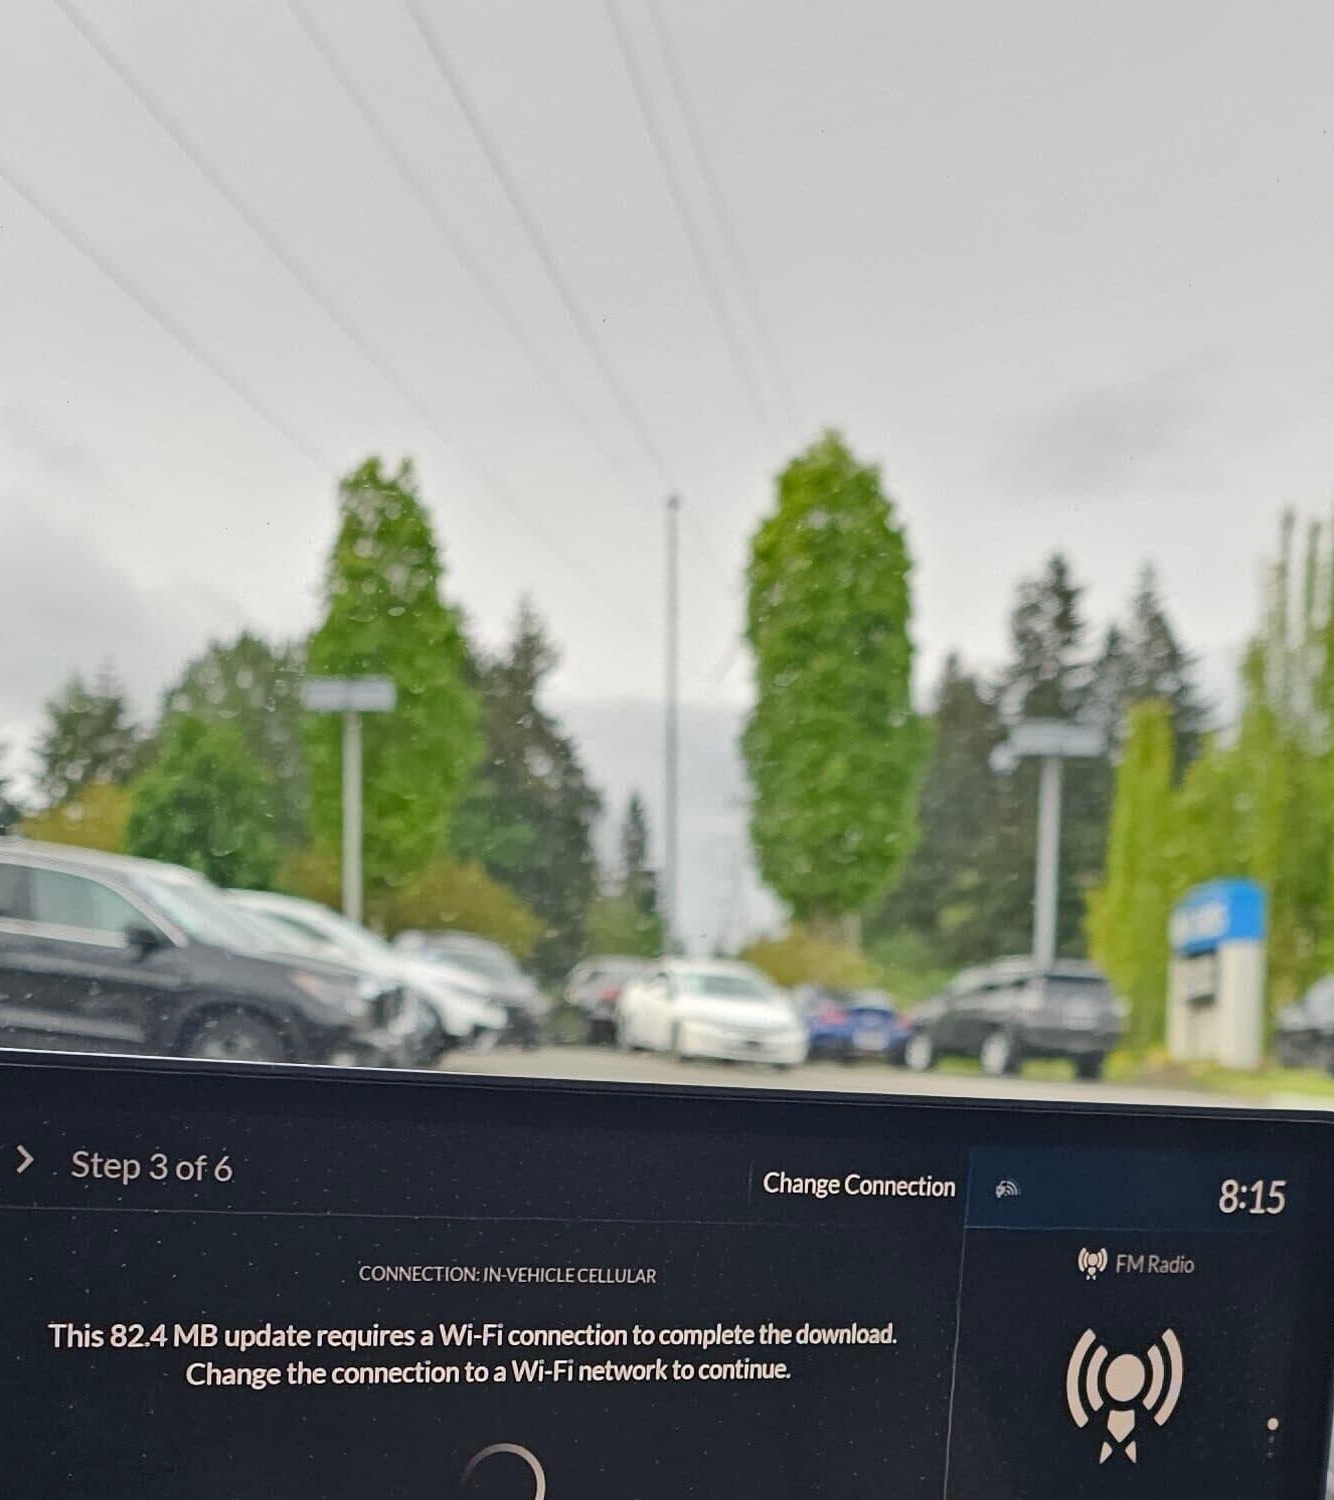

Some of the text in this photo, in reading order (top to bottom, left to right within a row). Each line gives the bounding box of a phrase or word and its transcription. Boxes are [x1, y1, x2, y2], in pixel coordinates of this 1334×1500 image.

[71, 1150, 233, 1186] Step 3 of 6
[763, 1171, 956, 1199] Change Connection
[1218, 1179, 1287, 1215] 8:15
[358, 1265, 657, 1284] CONNECTION: IN-VEHICLE CELLULAR
[1116, 1254, 1195, 1274] FM Radio
[48, 1322, 898, 1352] This 82.4 MB update requires a Wi-Fi connection to complete the download.
[185, 1358, 792, 1390] Change the connection to a Wi-Fi network to continue.
